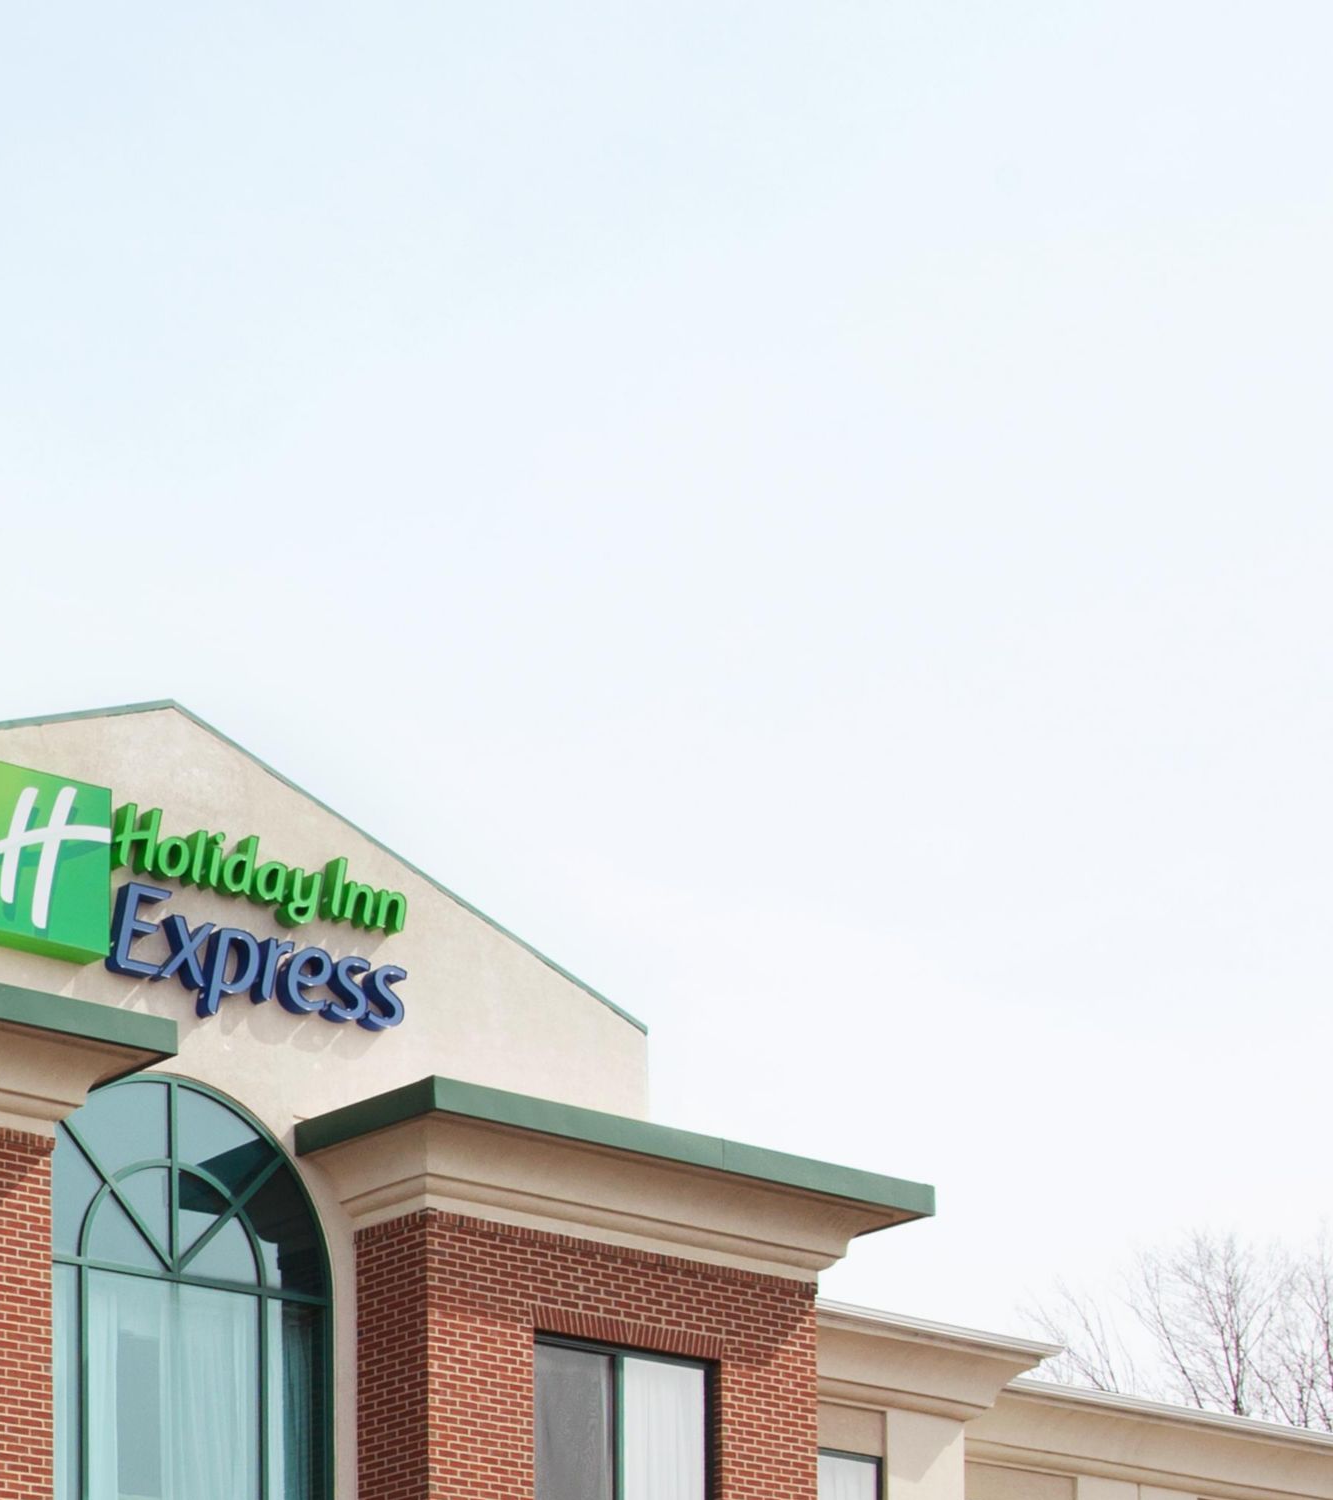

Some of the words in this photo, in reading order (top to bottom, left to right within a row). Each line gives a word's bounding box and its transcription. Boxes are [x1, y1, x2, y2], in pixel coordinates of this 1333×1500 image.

[112, 803, 323, 926] Holiday
[322, 857, 407, 935] Inn
[106, 881, 408, 1030] Express
